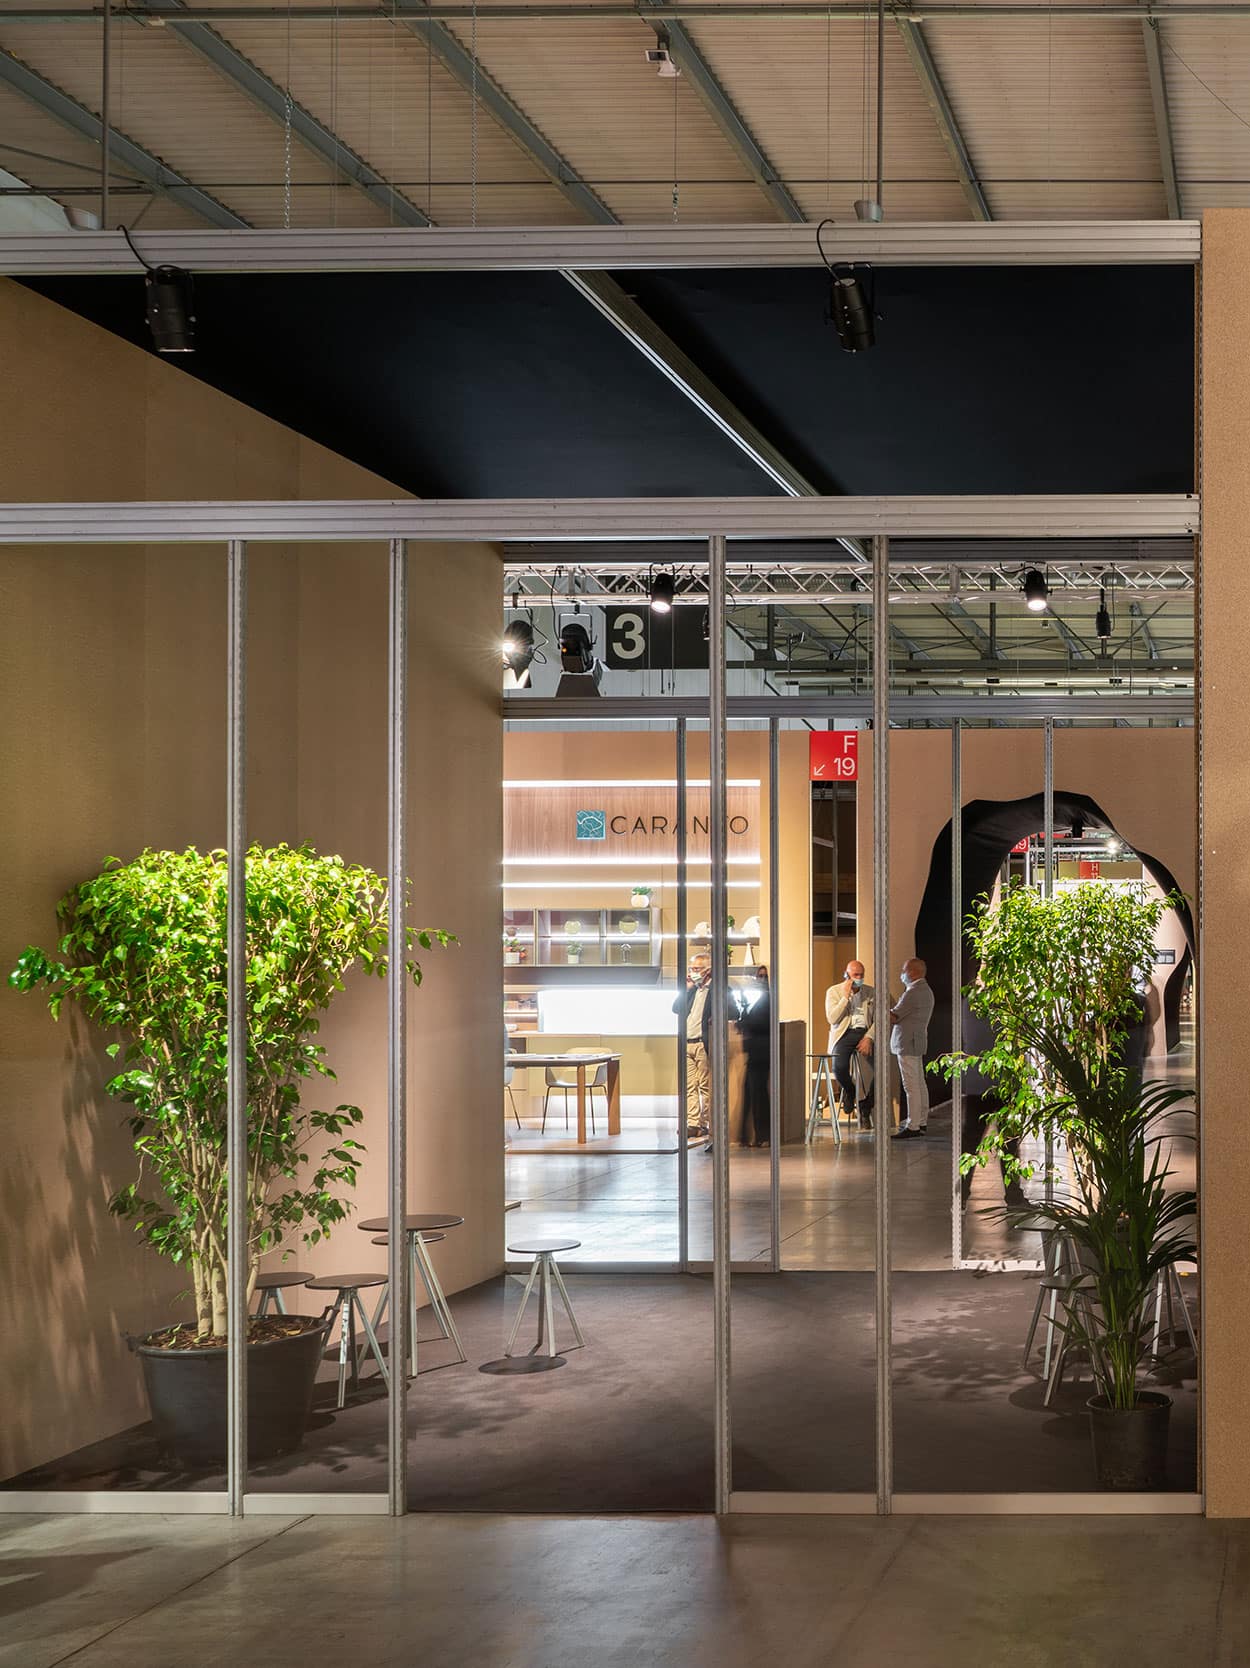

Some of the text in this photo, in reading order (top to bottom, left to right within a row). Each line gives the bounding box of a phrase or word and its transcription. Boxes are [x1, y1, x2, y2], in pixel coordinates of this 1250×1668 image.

[612, 612, 646, 660] 3
[844, 734, 856, 754] F
[833, 756, 856, 776] 19
[610, 815, 749, 835] CARNO
[1091, 863, 1098, 871] H
